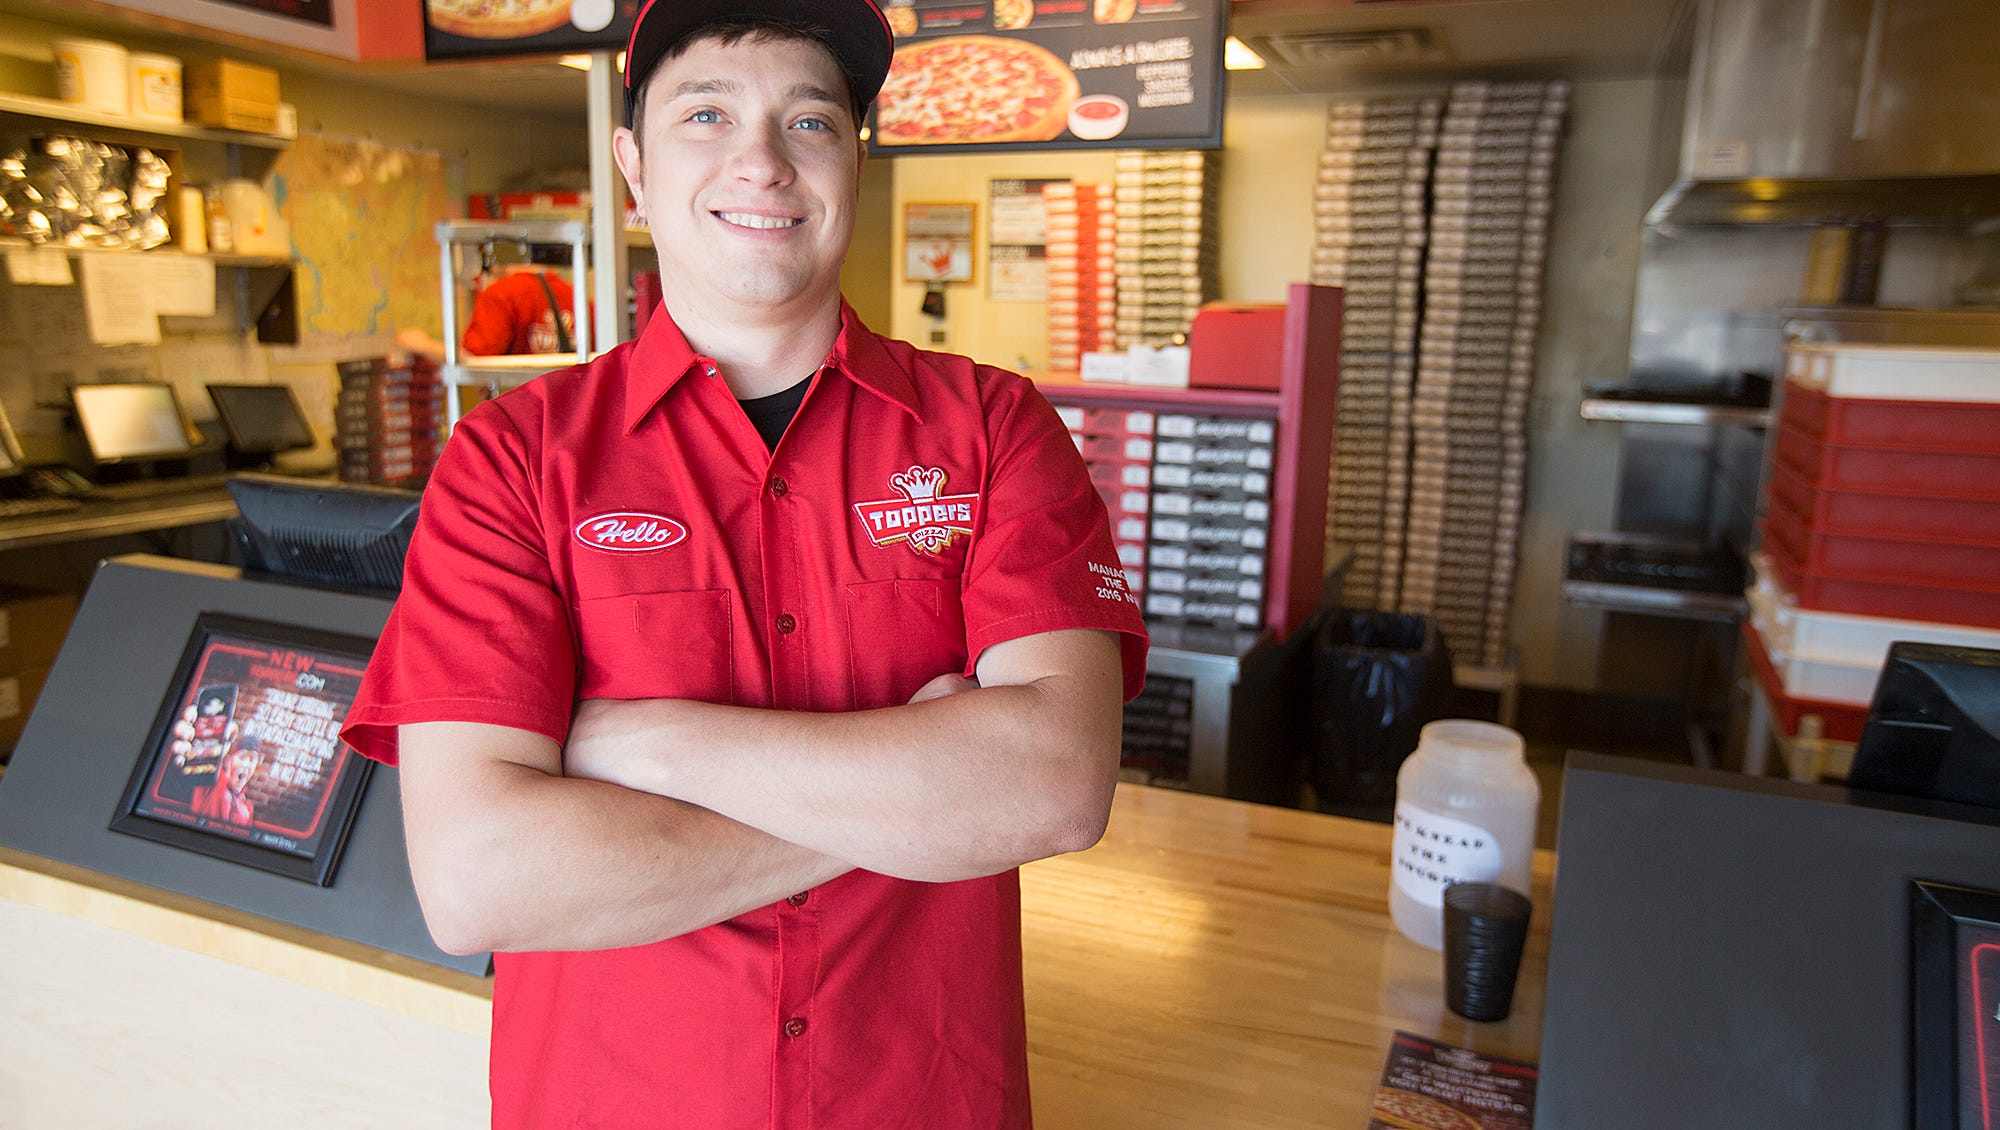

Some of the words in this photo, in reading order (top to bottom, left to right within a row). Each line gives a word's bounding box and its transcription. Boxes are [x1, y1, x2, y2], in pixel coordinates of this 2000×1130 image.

[592, 519, 672, 543] Hello
[914, 530, 944, 540] PIZZA
[1102, 576, 1126, 591] THE
[1095, 586, 1122, 602] 2016
[269, 651, 316, 672] NEW
